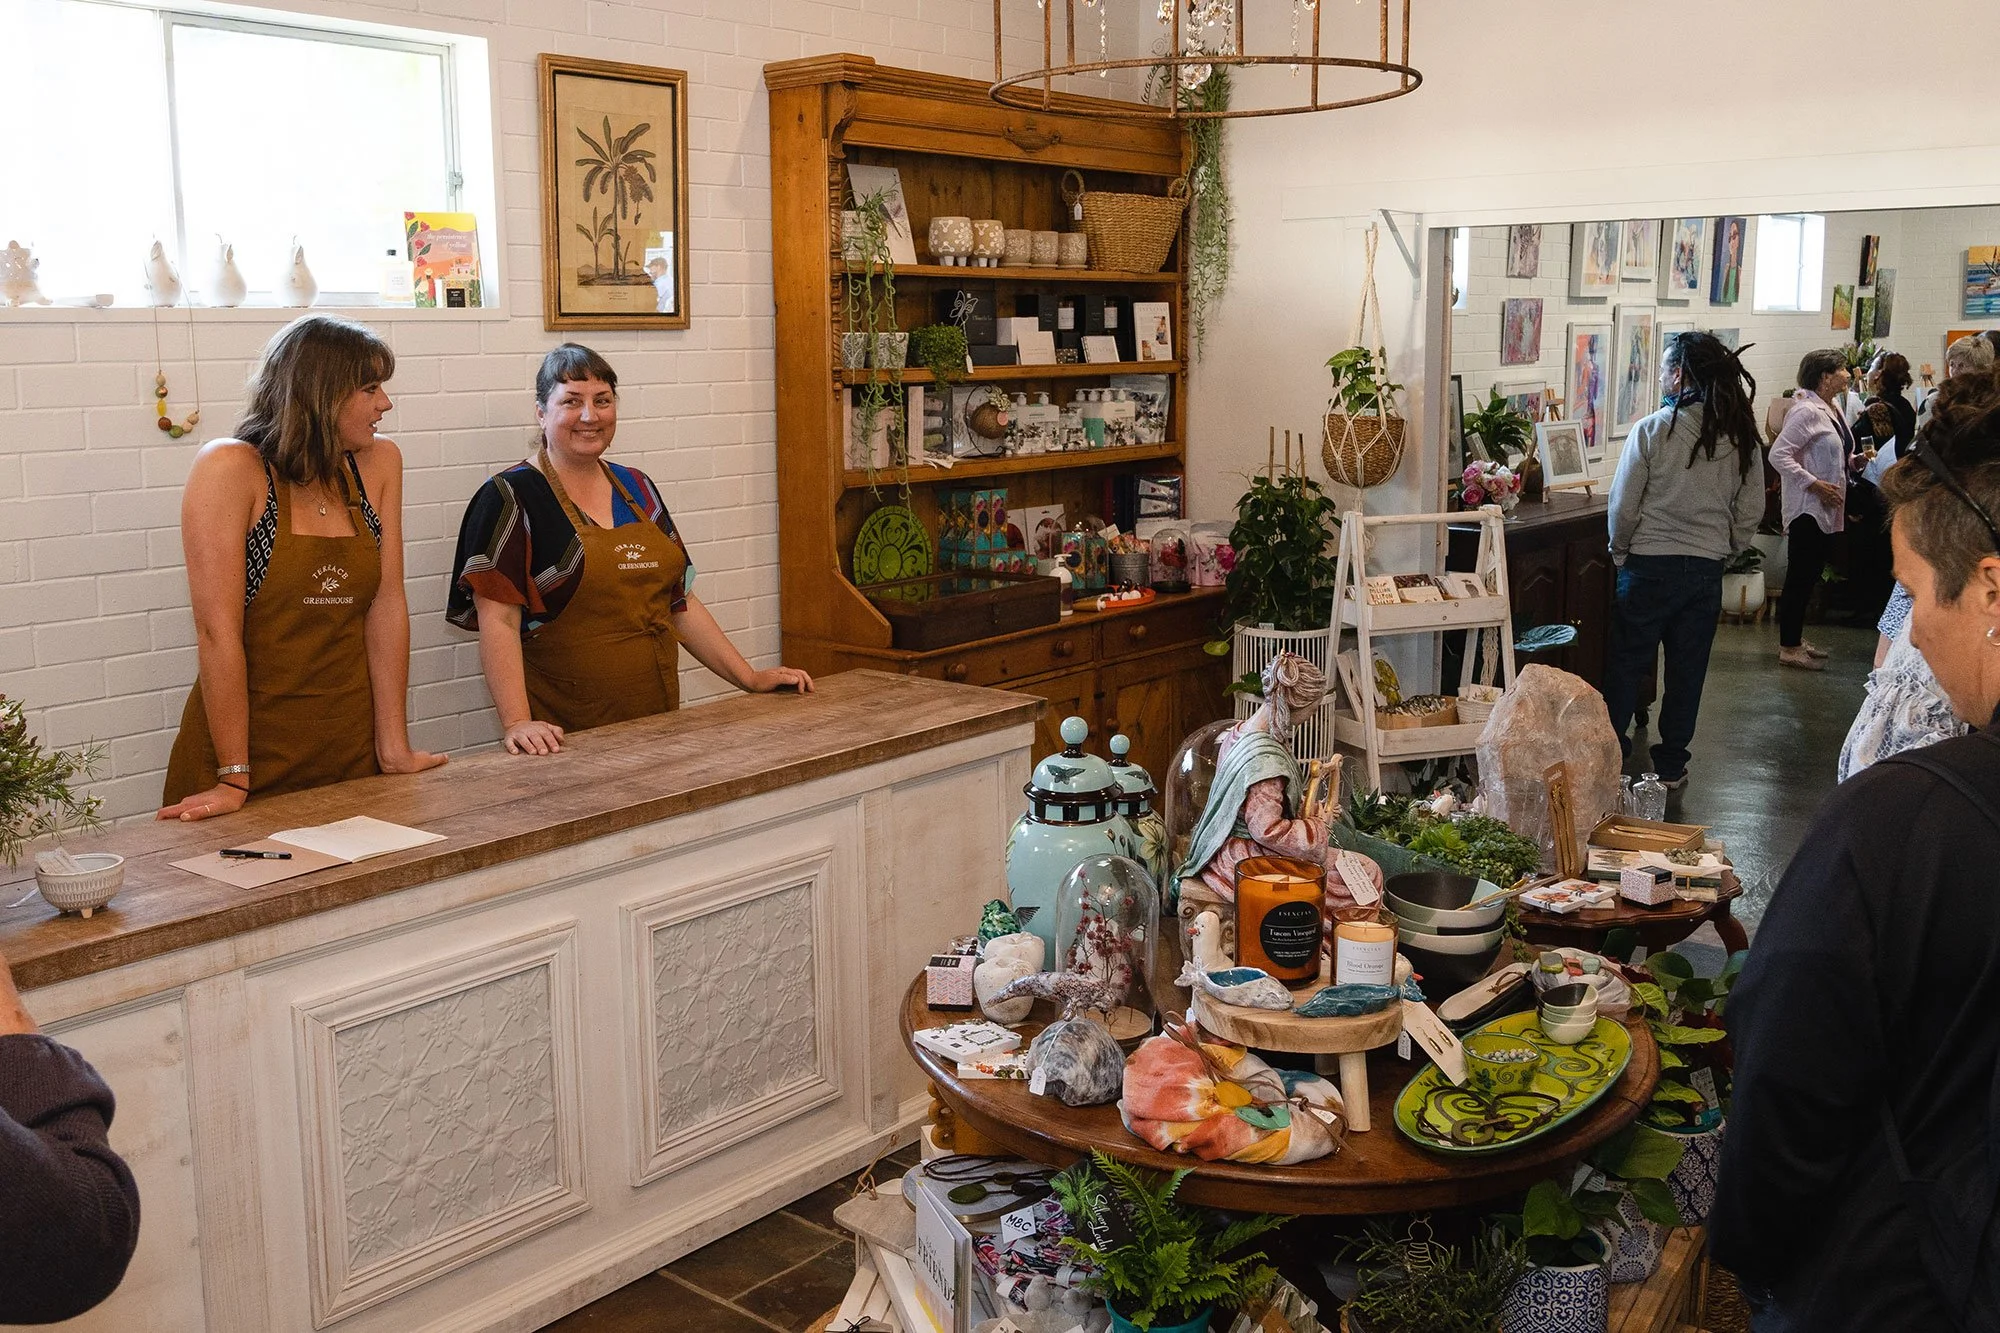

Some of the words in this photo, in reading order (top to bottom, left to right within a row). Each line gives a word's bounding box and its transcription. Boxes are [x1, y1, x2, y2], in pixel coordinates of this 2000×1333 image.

[614, 543, 647, 553] TERRACE
[311, 564, 349, 580] TERRACE
[617, 561, 659, 570] GREENHOUSE
[303, 596, 354, 605] GREENHOUSE
[1345, 960, 1363, 969] Blood
[1085, 1193, 1111, 1226] Silver
[1005, 1214, 1032, 1232] M&C
[1086, 1220, 1114, 1251] Lady
